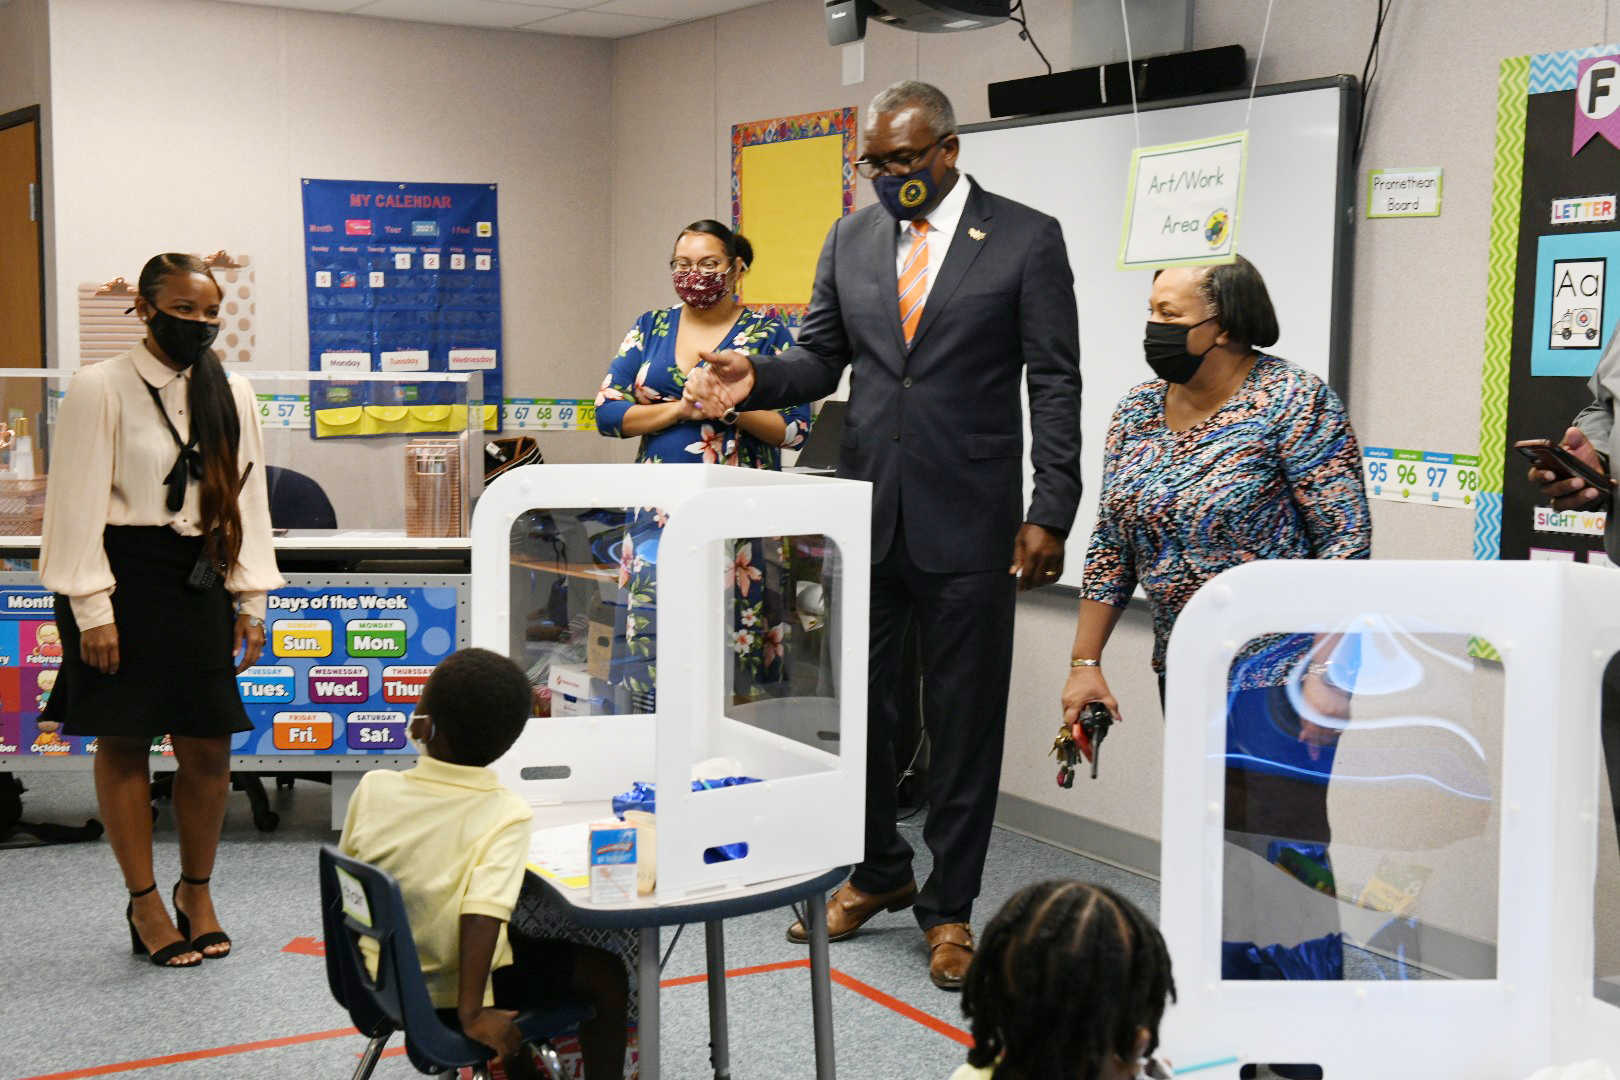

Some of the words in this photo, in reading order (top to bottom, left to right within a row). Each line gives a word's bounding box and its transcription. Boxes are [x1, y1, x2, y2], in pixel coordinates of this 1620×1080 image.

[1588, 67, 1615, 114] F
[1148, 166, 1224, 195] Art/Work
[1374, 176, 1435, 191] Promethean
[350, 193, 372, 207] MY
[375, 194, 452, 209] CALENDAR
[1387, 196, 1419, 211] Board
[1555, 201, 1612, 220] LETTER
[1161, 215, 1200, 235] Area
[1556, 269, 1600, 298] Aa
[278, 404, 296, 417] 57
[514, 407, 529, 420] 67
[537, 407, 552, 420] 68
[559, 407, 574, 420] 69
[1368, 461, 1388, 482] 95
[1397, 463, 1417, 485] 96
[1427, 466, 1448, 488] 97
[1457, 469, 1477, 491] 98
[1537, 513, 1577, 528] SIGHT
[268, 595, 309, 612] Days
[310, 594, 330, 609] of
[330, 595, 358, 609] the
[358, 595, 408, 609] Week
[283, 636, 321, 651] Sun.
[353, 636, 400, 651] Mon.
[240, 682, 289, 697] Tues.
[315, 682, 362, 697] Wed.
[289, 728, 317, 743] Fri.
[359, 728, 394, 743] Sat.
